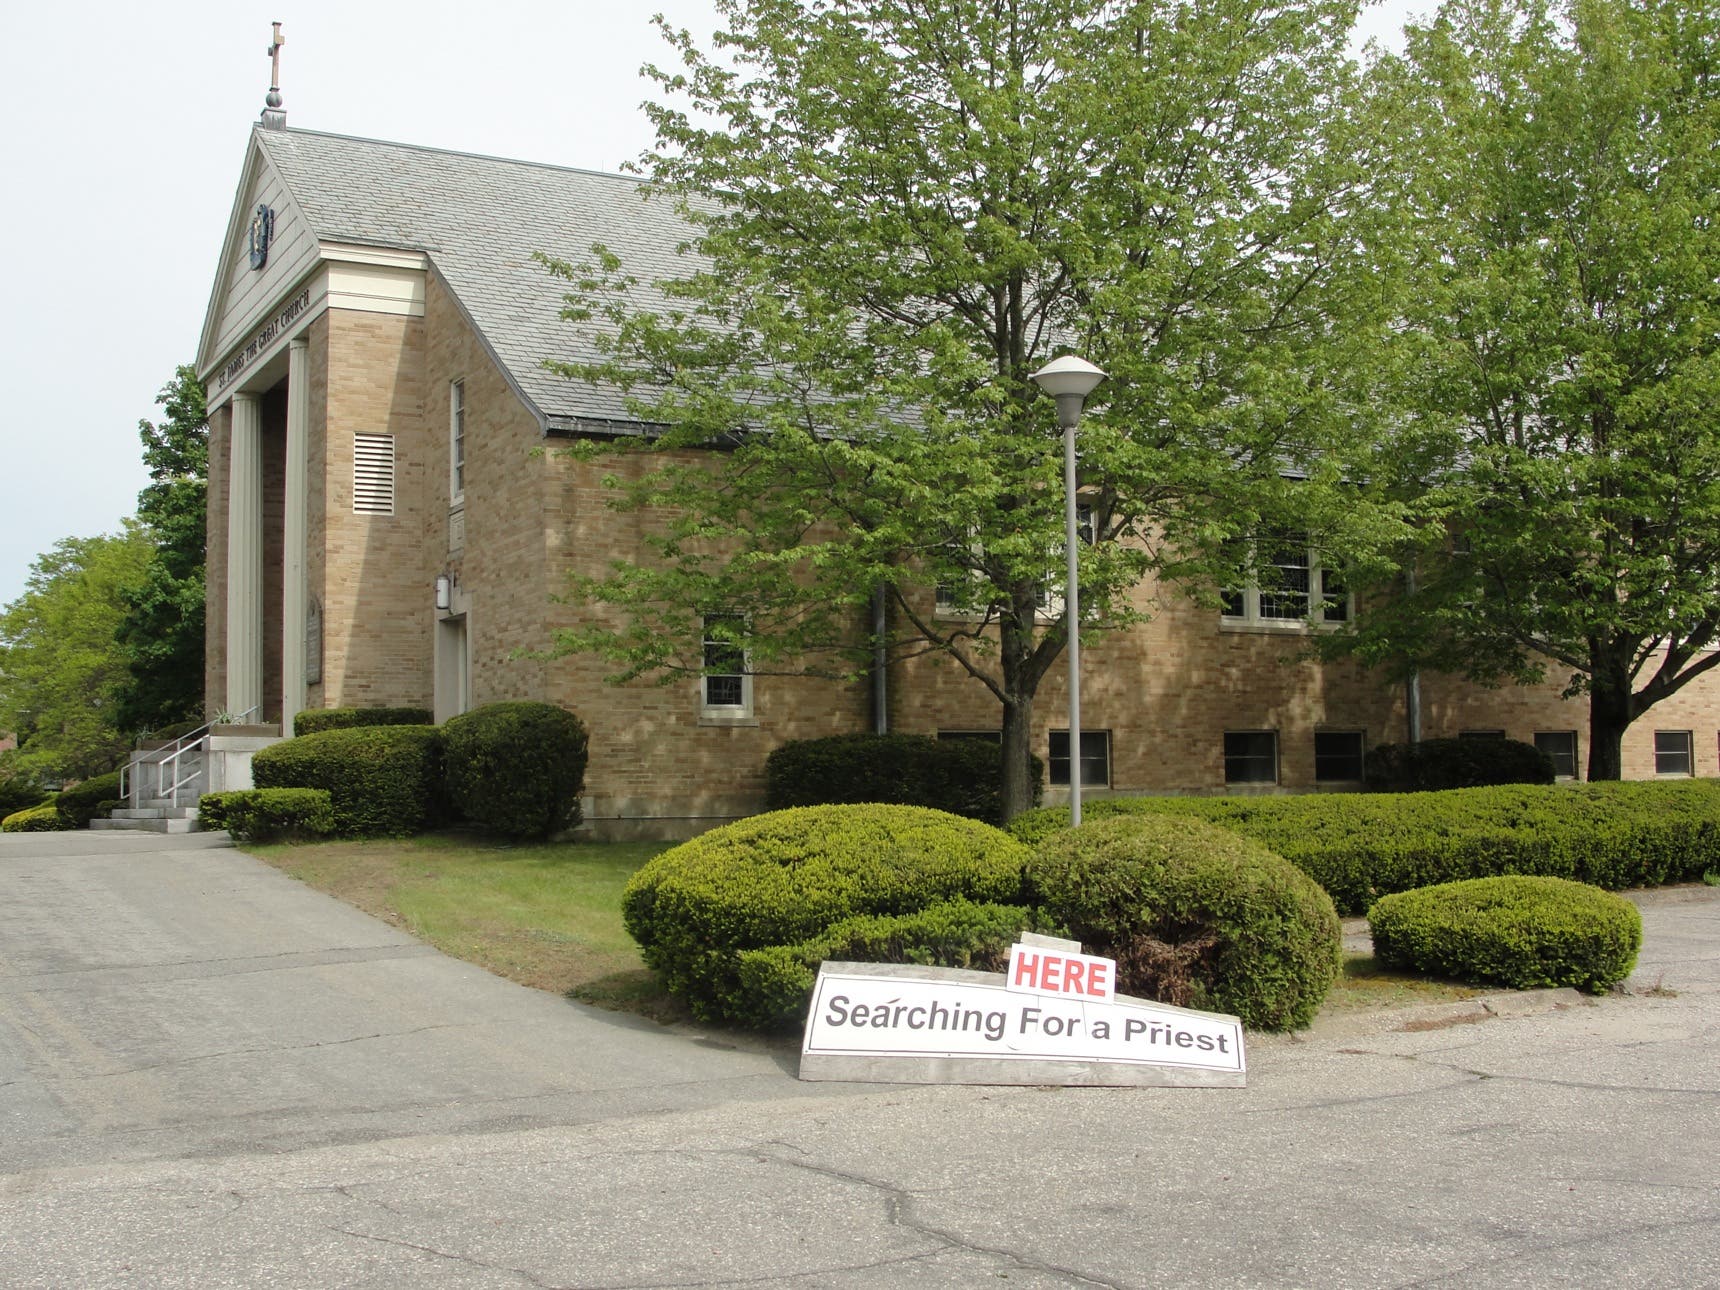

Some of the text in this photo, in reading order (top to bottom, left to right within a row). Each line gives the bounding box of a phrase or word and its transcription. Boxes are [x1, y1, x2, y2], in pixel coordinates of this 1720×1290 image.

[227, 353, 244, 382] JAMES
[245, 341, 257, 362] THE
[258, 318, 279, 349] GREAT
[280, 289, 309, 328] CHURCH
[1014, 951, 1107, 996] HERE
[825, 995, 1229, 1055] Searching For a Priest
